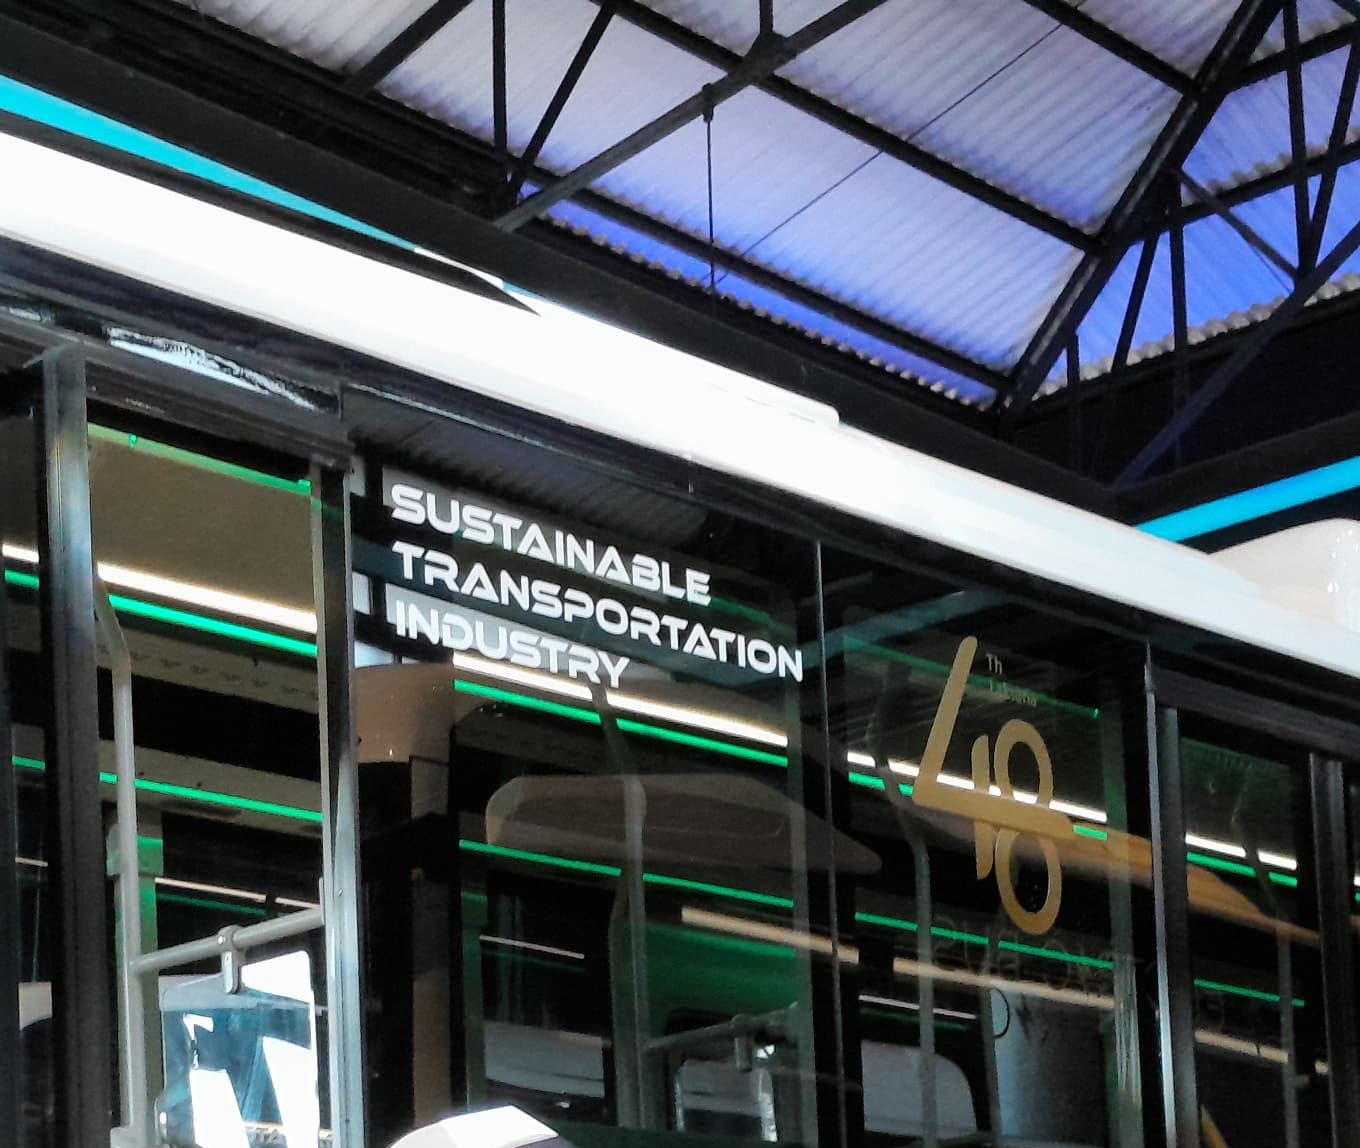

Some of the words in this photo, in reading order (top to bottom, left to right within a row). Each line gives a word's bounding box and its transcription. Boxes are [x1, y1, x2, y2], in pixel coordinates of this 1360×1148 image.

[390, 484, 712, 606] SUSTAINABLE
[391, 541, 804, 683] TRANSPORTATION
[395, 600, 630, 689] INDUSTRY
